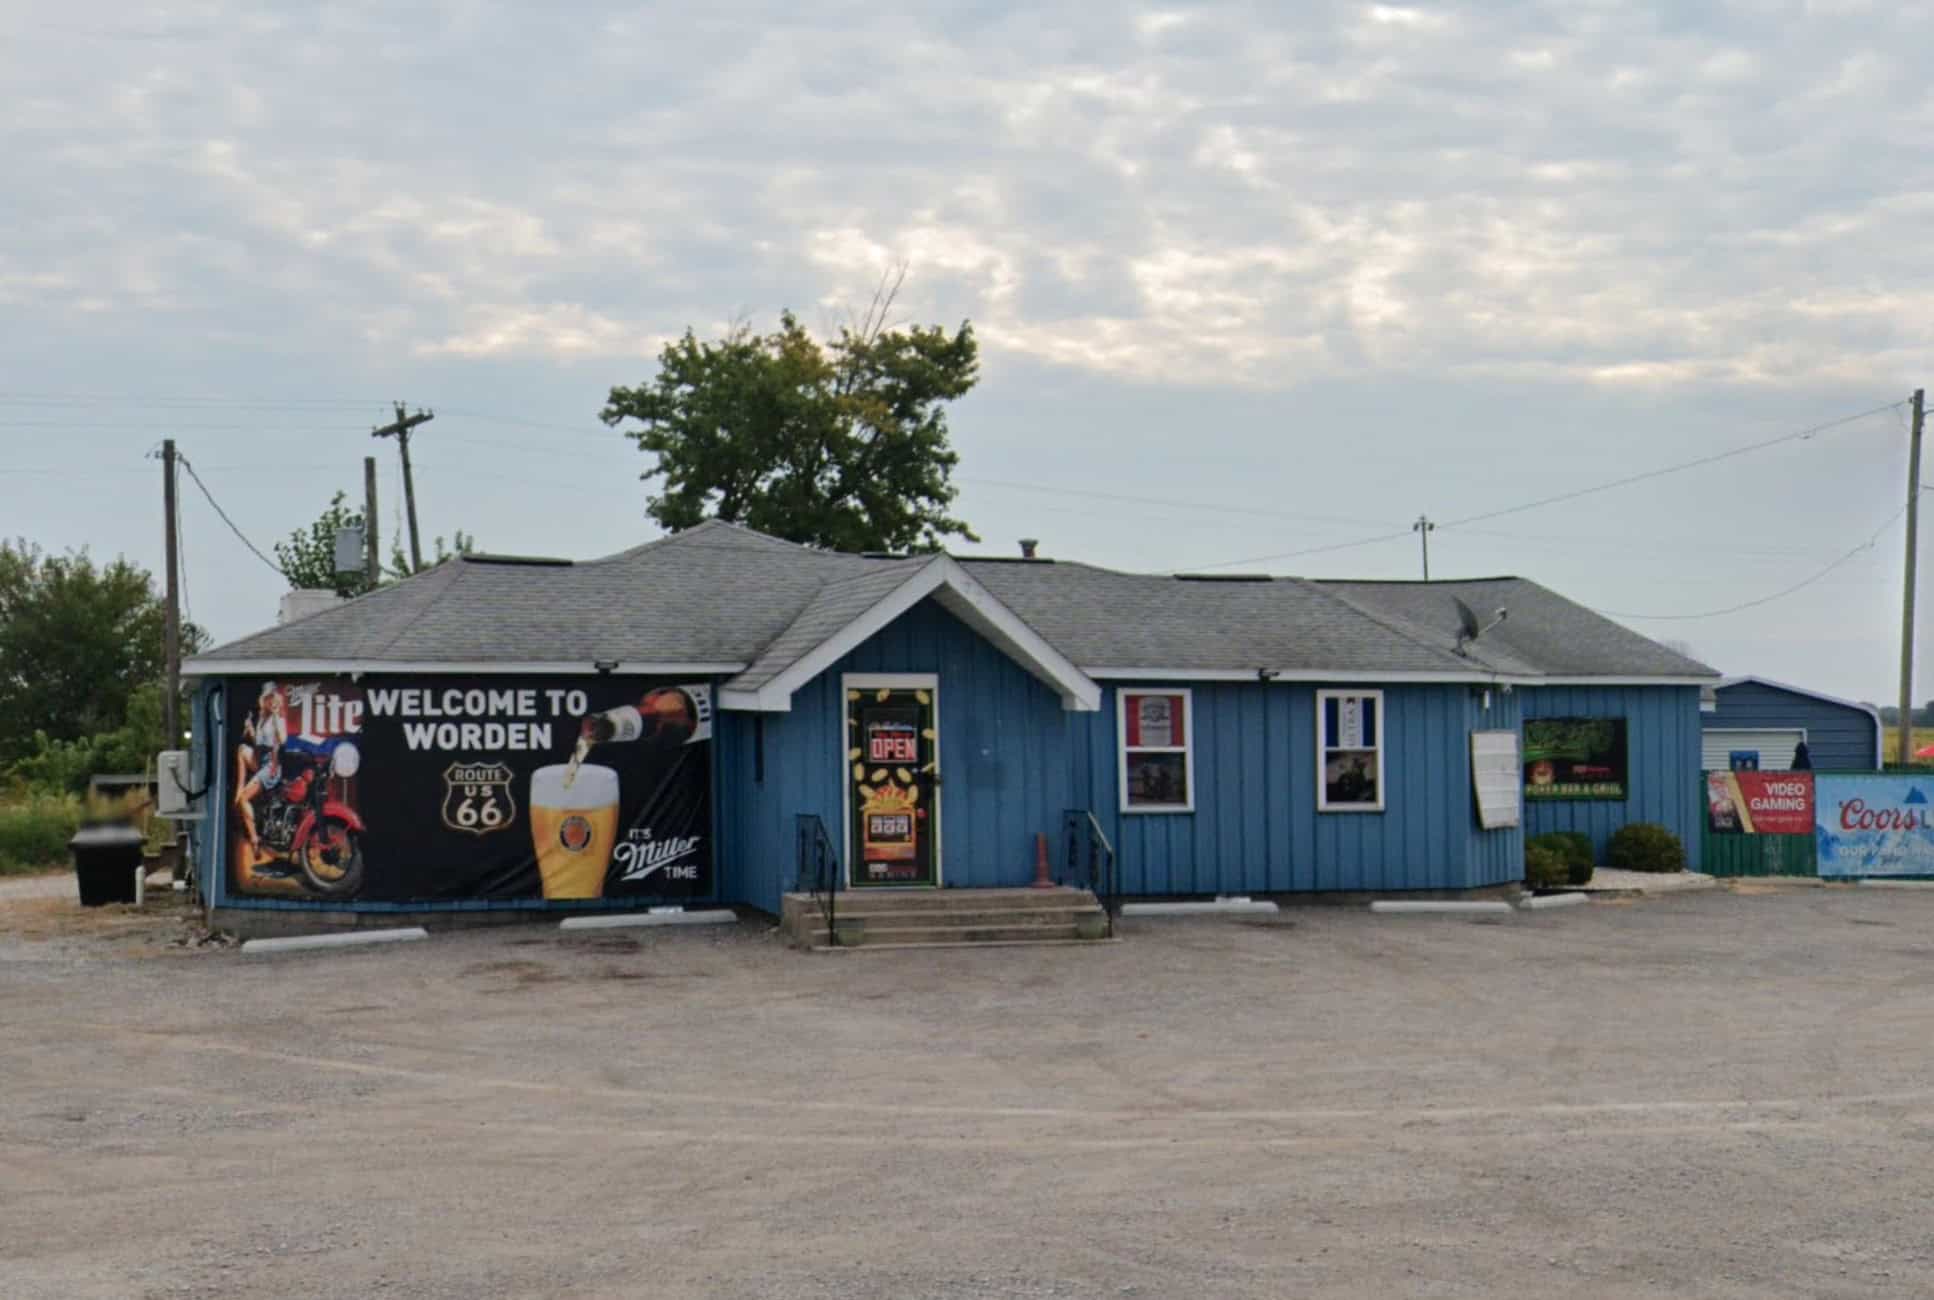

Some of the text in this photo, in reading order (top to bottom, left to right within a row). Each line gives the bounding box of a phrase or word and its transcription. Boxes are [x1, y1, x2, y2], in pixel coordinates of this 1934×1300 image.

[367, 688, 588, 716] WELCOME TO
[299, 693, 364, 745] Lite
[403, 722, 552, 750] WORDEN
[871, 738, 917, 760] OPEN
[455, 768, 502, 781] ROUTE
[1765, 783, 1805, 796] VIDEO
[456, 798, 501, 826] 66
[1751, 798, 1805, 810] GAMING
[1838, 798, 1918, 830] Coors
[613, 836, 700, 880] Miller
[664, 865, 697, 878] TIME
